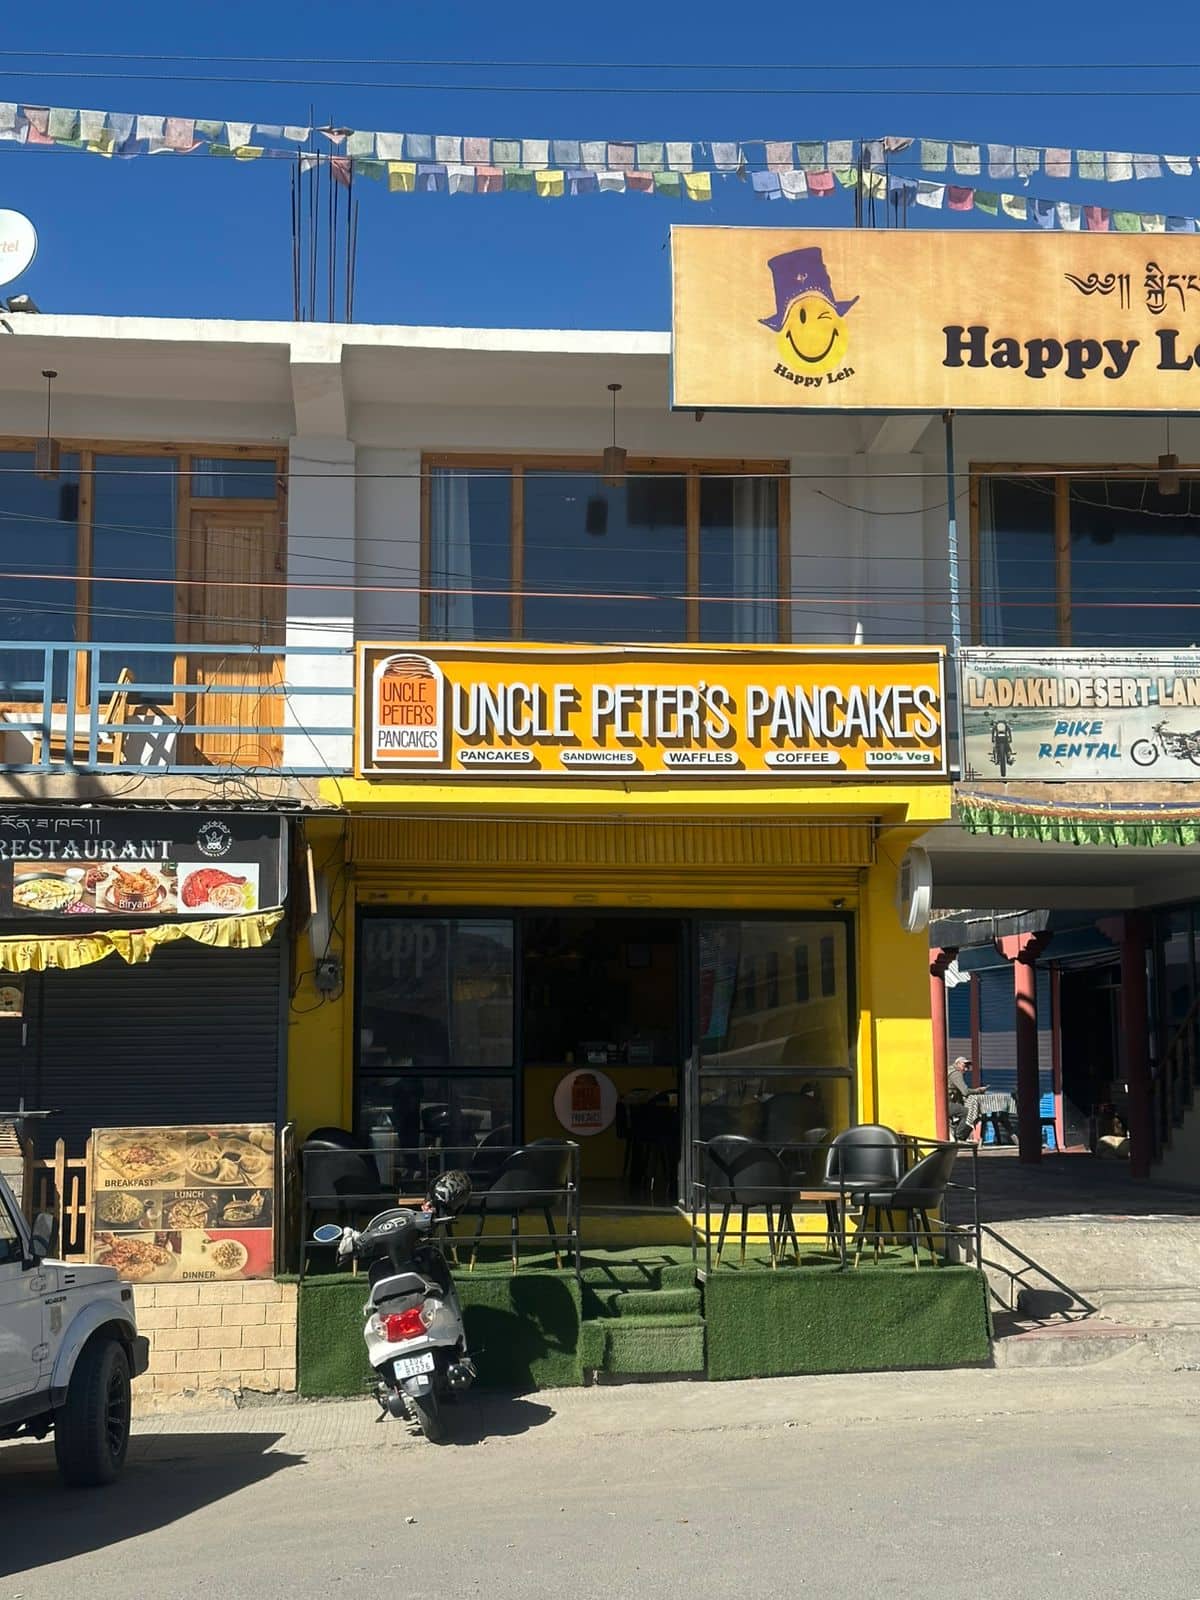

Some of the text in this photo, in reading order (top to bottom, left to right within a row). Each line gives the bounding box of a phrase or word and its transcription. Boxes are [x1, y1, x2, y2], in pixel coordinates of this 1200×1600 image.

[941, 325, 1140, 380] Happy
[773, 357, 856, 388] Happy Leh
[382, 682, 428, 703] UNCLE
[967, 676, 1060, 708] LADAKH
[1062, 676, 1152, 708] DESERT
[382, 704, 435, 726] PETER'S
[452, 680, 939, 742] UNCLE PETER'S PANCAKES
[1054, 720, 1105, 738] BIKE
[378, 730, 439, 748] PANCAKES
[460, 751, 530, 762] PANCAKES
[562, 752, 634, 762] SANDWICHES
[669, 752, 733, 763] WAFFLES
[775, 752, 830, 763] COFFEE
[869, 752, 931, 764] 100% Veg
[1038, 742, 1123, 760] RENTAL
[104, 1178, 155, 1188] BREAKFAST
[174, 1190, 206, 1200] LUNCH
[182, 1270, 217, 1280] DINNER
